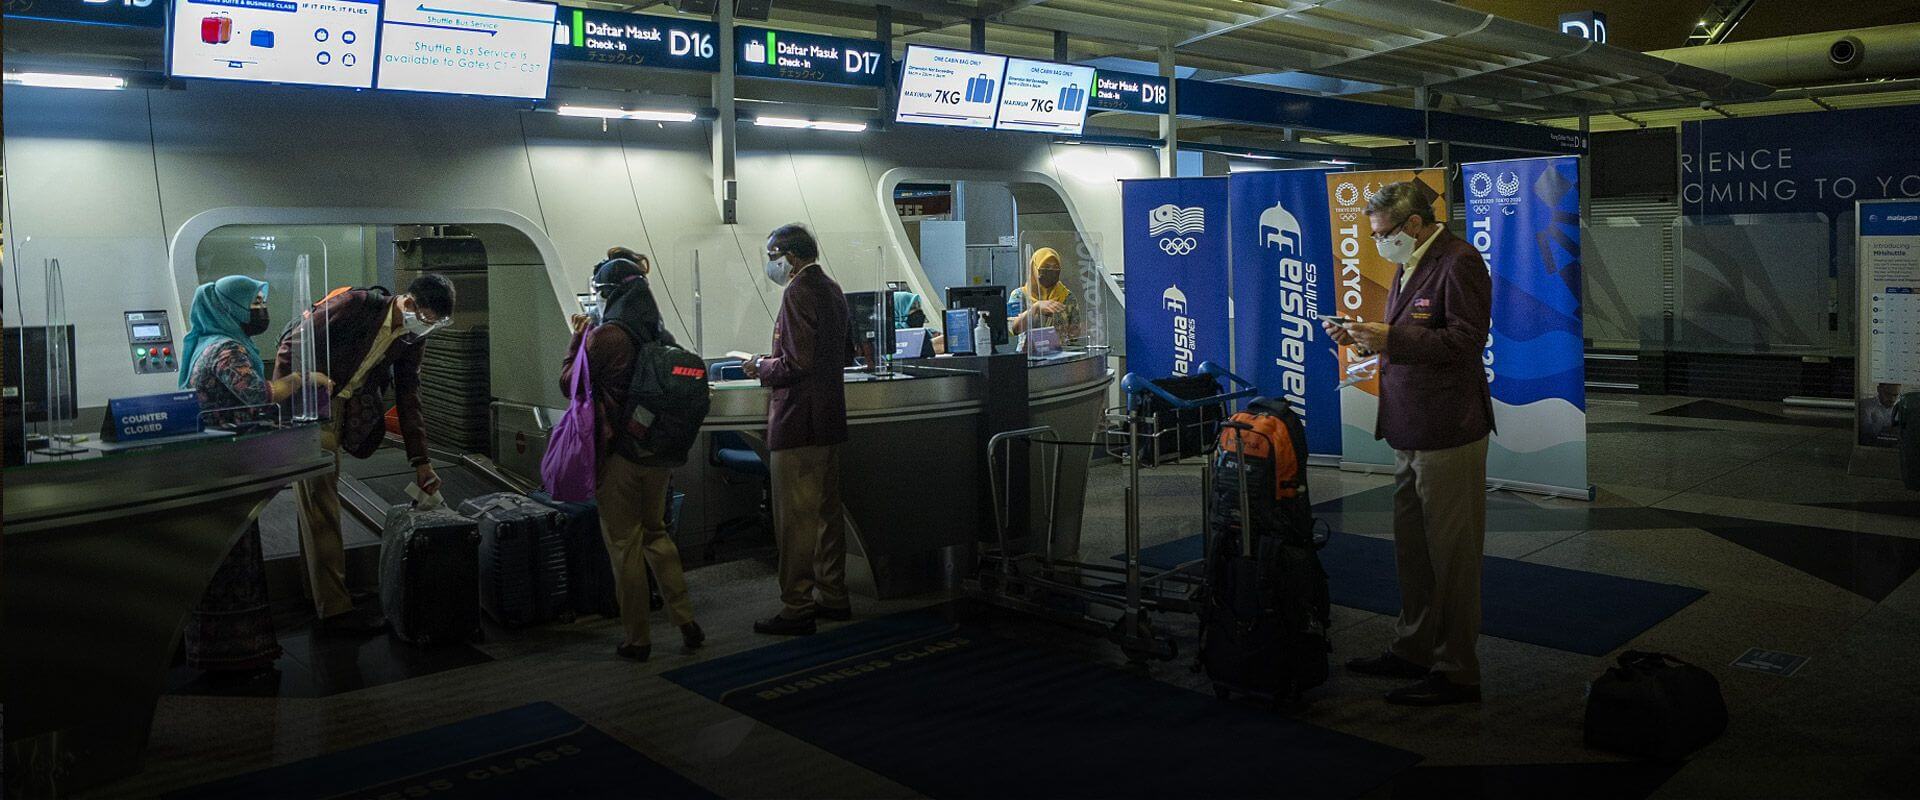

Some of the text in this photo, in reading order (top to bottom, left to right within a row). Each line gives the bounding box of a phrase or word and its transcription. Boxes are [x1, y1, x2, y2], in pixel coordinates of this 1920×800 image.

[427, 16, 499, 29] Shuttle Bus Service
[585, 21, 662, 41] Daftar Masuk
[415, 41, 528, 60] Shuttle Bus Service is
[670, 30, 714, 59] D16
[777, 42, 838, 60] Daftar Masuk
[385, 53, 440, 66] available
[444, 58, 454, 67] to
[458, 58, 490, 70] Gates
[845, 49, 881, 75] D17
[1098, 79, 1139, 92] Daftar Masuk
[1142, 83, 1167, 105] D18
[904, 89, 960, 105] MAXIMUM 7KG
[1004, 98, 1054, 113] MAXIMUM 7KG
[1814, 177, 1856, 199] TO
[1339, 224, 1363, 310] TOKYO
[1304, 262, 1318, 320] airlines
[1187, 318, 1196, 350] airlines
[121, 411, 168, 425] COUNTER
[123, 423, 163, 436] CLOSED
[756, 638, 970, 700] BUSINESS CLASS
[464, 744, 583, 780] CLASS
